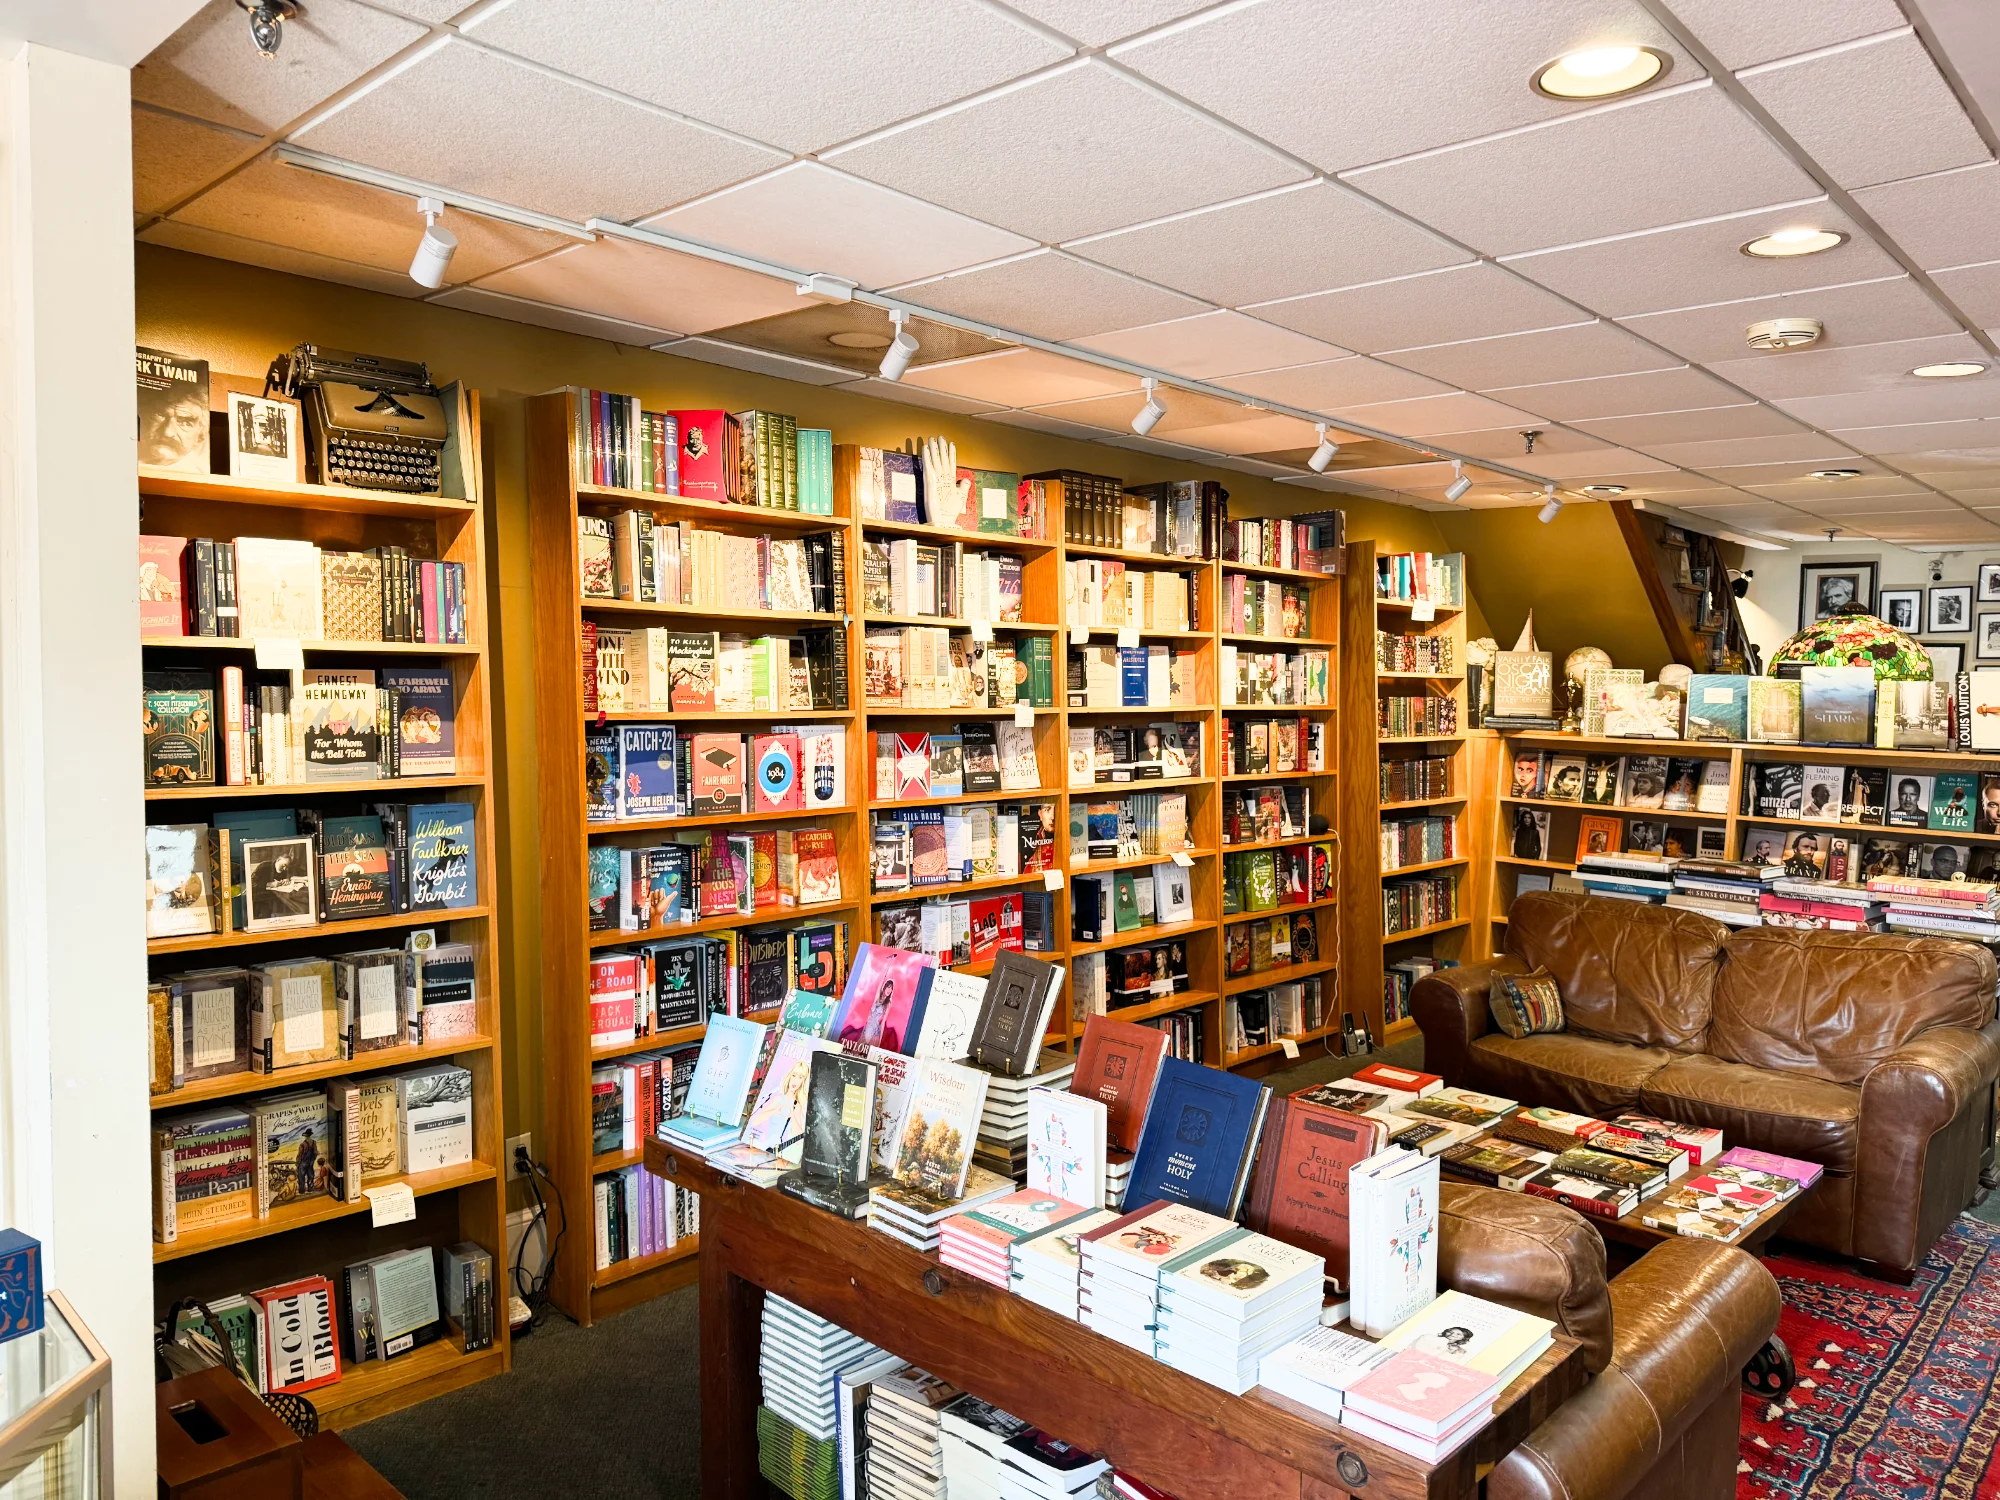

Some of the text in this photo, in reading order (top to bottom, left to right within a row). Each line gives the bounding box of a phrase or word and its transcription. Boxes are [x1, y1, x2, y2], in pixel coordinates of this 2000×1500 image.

[154, 363, 198, 383] TWAIN
[866, 552, 878, 560] THE
[864, 560, 889, 569] DERALIST
[864, 566, 882, 575] PAPERS
[668, 645, 713, 658] Mockingbird
[1498, 655, 1550, 664] VANITY FAIR
[1497, 664, 1550, 676] OSCAR
[318, 676, 358, 686] ERNEST
[388, 678, 450, 686] A FAREWELL
[1497, 674, 1550, 689] NIGHT
[306, 690, 367, 700] HEMINGWAY
[412, 686, 442, 694] ARMS
[1498, 688, 1550, 696] SESSIONS
[1958, 675, 1971, 746] LOUIS VUITTON
[1814, 714, 1863, 724] SHARKS
[314, 739, 363, 748] For Whom
[589, 738, 613, 747] NEALE
[626, 731, 673, 752] CATCH-22
[310, 749, 367, 759] the Bell Tolls
[586, 745, 615, 753] HURSTON
[768, 767, 786, 780] 1984
[1631, 764, 1662, 774] McCullers
[702, 774, 736, 786] FAHRENHEIT
[1706, 778, 1730, 787] Mercy
[1805, 773, 1840, 782] FLEMING
[627, 796, 675, 809] JOSEPH HELLER
[715, 792, 725, 800] 451
[599, 804, 615, 812] WERE
[1160, 804, 1184, 812] FRANKL
[1760, 797, 1792, 809] CITIZEN
[1841, 803, 1884, 816] RESPECT
[903, 813, 920, 821] SILK
[1776, 807, 1800, 820] CASH
[1934, 806, 1964, 817] Wild
[1586, 821, 1614, 831] GRACE
[1942, 817, 1968, 827] Life
[416, 819, 464, 840] William
[324, 832, 376, 847] OLD MAN
[805, 833, 833, 842] CATCHER
[1022, 836, 1053, 849] NAPOLEON
[412, 841, 469, 859] Faulkner
[1161, 841, 1184, 849] MEANING
[328, 850, 375, 865] THE SEA
[701, 847, 728, 859] FLEW
[413, 860, 468, 886] Knight's
[713, 868, 732, 880] THE
[1164, 873, 1188, 881] OLIVER
[1610, 867, 1651, 880] LUXURY
[1785, 865, 1819, 878] GRANT
[341, 878, 373, 892] Ernest
[1893, 885, 1918, 894] CASH
[328, 890, 384, 905] Hemingway
[414, 883, 468, 903] Gambit
[709, 890, 735, 903] NEST
[1696, 890, 1718, 899] SENSE
[1730, 893, 1751, 902] PLACE
[1888, 894, 1920, 903] AMERICAN
[1922, 896, 1938, 904] PAINT
[1896, 917, 1976, 930] REMOTE EXPERIENCES
[671, 955, 682, 963] ZEN
[748, 941, 786, 964] OUTSIDERS
[362, 970, 393, 986] WILLIAM
[601, 966, 615, 977] ON
[606, 975, 633, 987] ROAD
[285, 980, 319, 996] WILLIAM
[362, 984, 393, 1000] FAULKNER
[196, 991, 231, 1009] WILLIAM
[286, 993, 320, 1011] FAULKNER
[661, 990, 695, 1001] MOTORCYCLE
[660, 998, 697, 1010] MAINTENANCE
[748, 1003, 759, 1012] S.E.
[196, 1006, 232, 1026] FAULKNER
[596, 1005, 621, 1019] JACK
[786, 1003, 824, 1020] Embrace
[792, 1020, 810, 1034] Your
[196, 1032, 232, 1059] DYING
[841, 1038, 870, 1054] TAYLOR
[707, 1068, 730, 1080] GIFT
[930, 1071, 966, 1090] Wisdom
[643, 1076, 651, 1100] HUNTER
[663, 1071, 671, 1111] GONZO
[703, 1087, 721, 1099] SEA
[1099, 1087, 1119, 1096] moment
[1099, 1092, 1117, 1102] HOLY
[299, 1102, 325, 1114] WRATH
[273, 1115, 317, 1132] John Steinbeck
[176, 1142, 190, 1150] The
[192, 1140, 216, 1148] Moon
[227, 1134, 248, 1142] Down
[420, 1141, 462, 1153] STEINBECK
[176, 1147, 220, 1161] The Red
[1174, 1152, 1194, 1162] EVERY
[1307, 1145, 1343, 1170] Jesus
[186, 1155, 249, 1172] MICE MEN
[1168, 1156, 1197, 1171] moment
[177, 1165, 249, 1187] Cannery Row
[1166, 1164, 1193, 1180] HOLY
[1557, 1164, 1598, 1179] MARY OLIVER
[1297, 1162, 1349, 1196] Calling
[208, 1178, 250, 1196] Pearl
[184, 1208, 203, 1219] JOHN
[206, 1200, 247, 1215] STEINBECK
[1395, 1288, 1430, 1312] AN EASTER
[1392, 1297, 1431, 1324] ANTHOLOGY
[310, 1288, 334, 1363] Blood
[278, 1296, 305, 1387] In Cold
